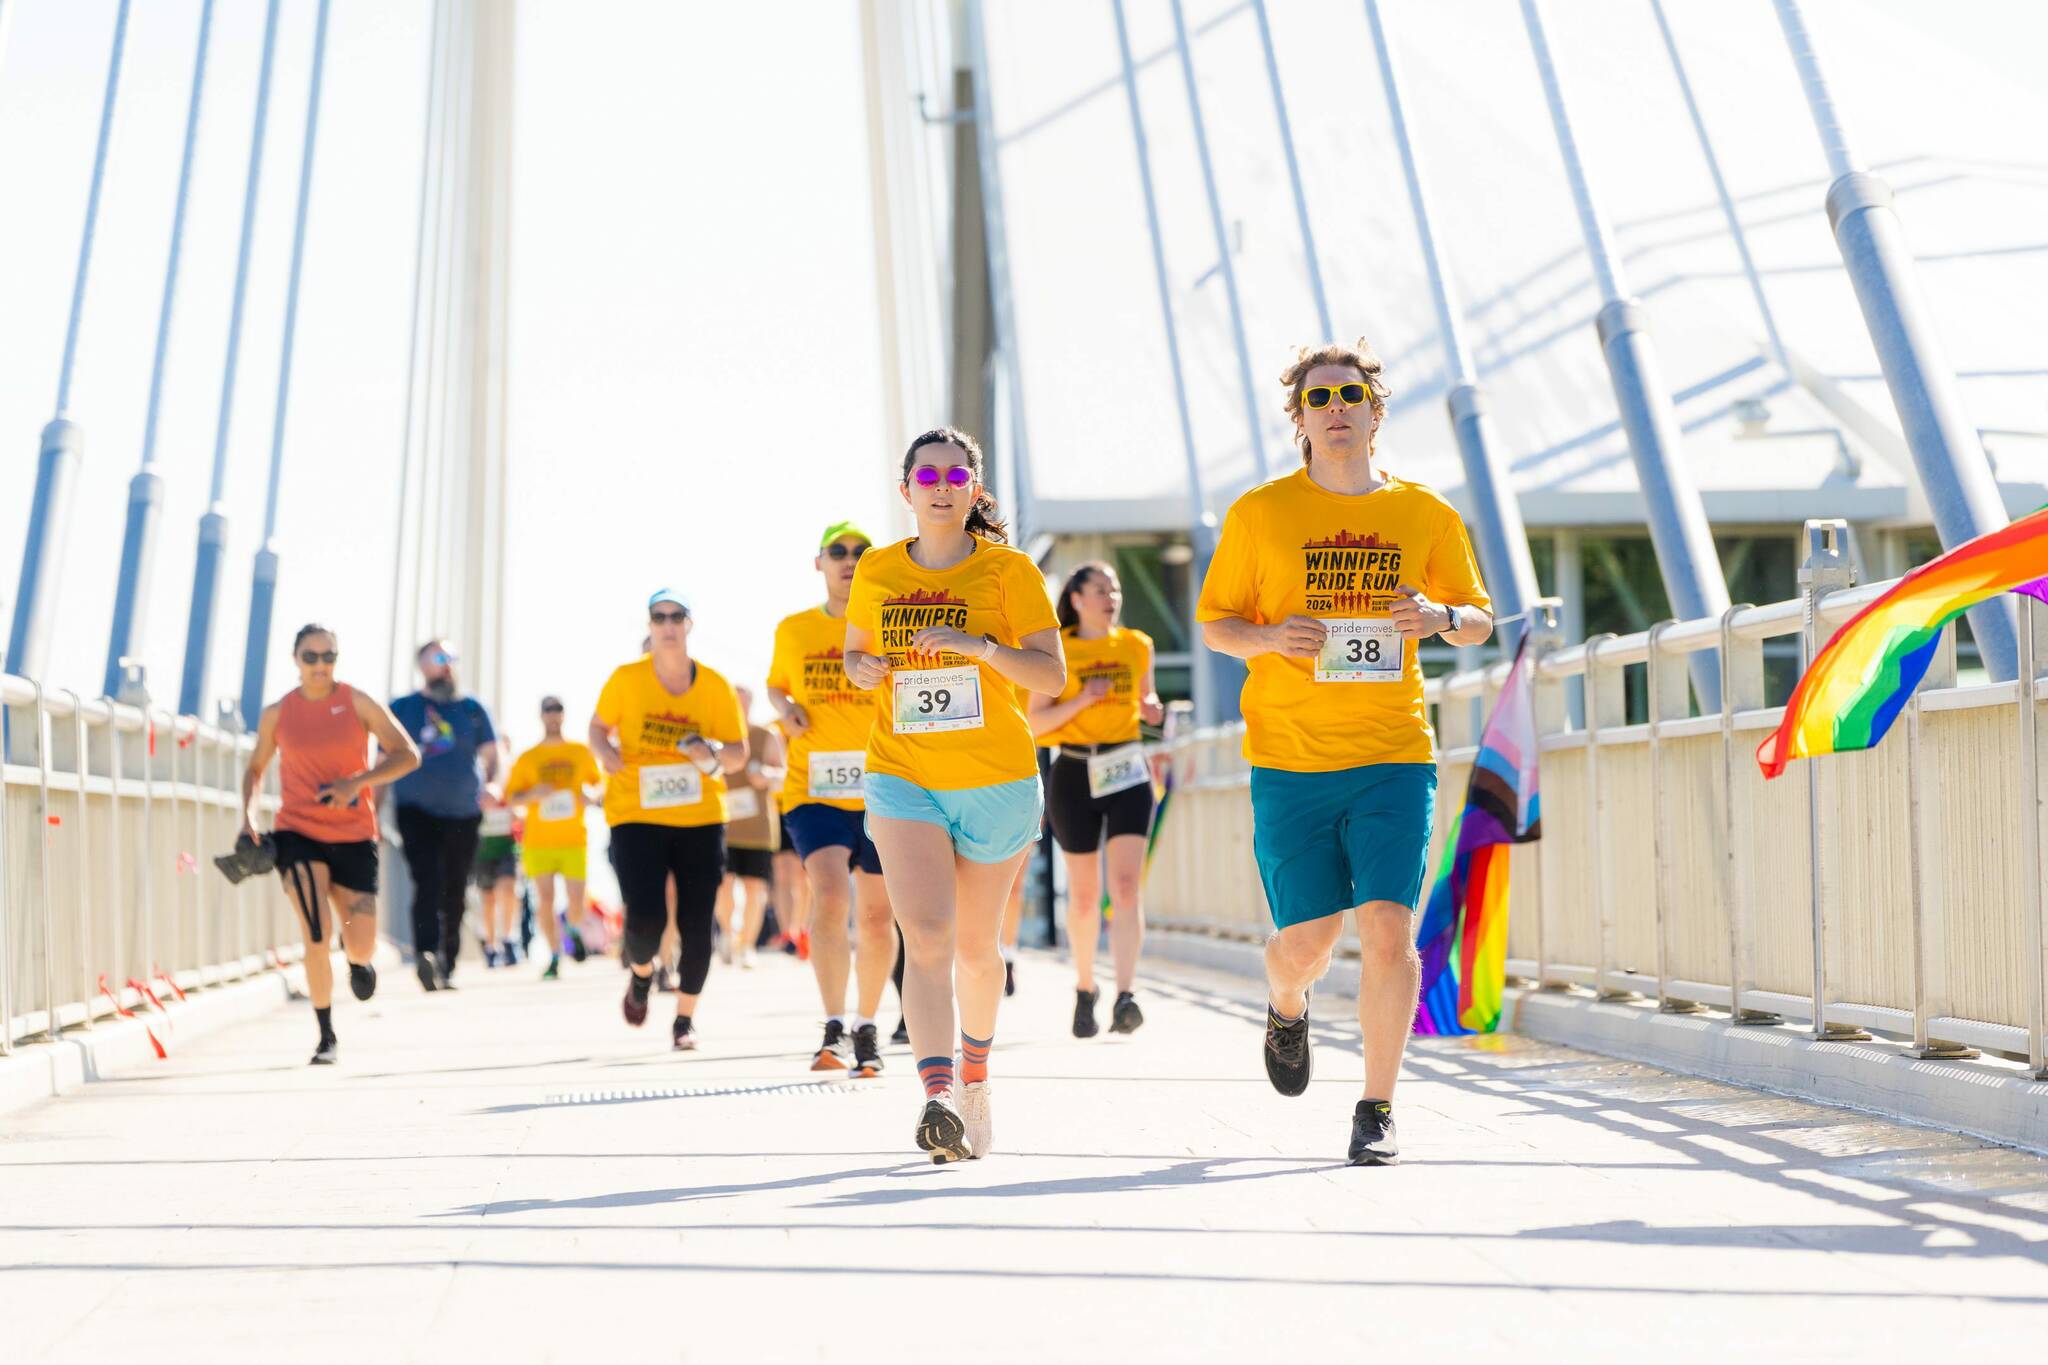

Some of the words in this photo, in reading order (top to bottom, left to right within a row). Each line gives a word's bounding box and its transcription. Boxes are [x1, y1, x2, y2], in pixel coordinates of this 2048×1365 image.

[1305, 551, 1401, 572] WINNIPEG
[1306, 572, 1356, 590] PRIDE
[1361, 573, 1399, 591] RUN
[1306, 600, 1332, 610] 2024
[881, 608, 968, 628] WINNIPEG
[882, 629, 922, 648] PRID
[1346, 639, 1381, 663] 38
[889, 656, 906, 667] 202
[804, 678, 840, 690] PRIDE
[917, 689, 951, 714] 39
[826, 767, 861, 784] 159
